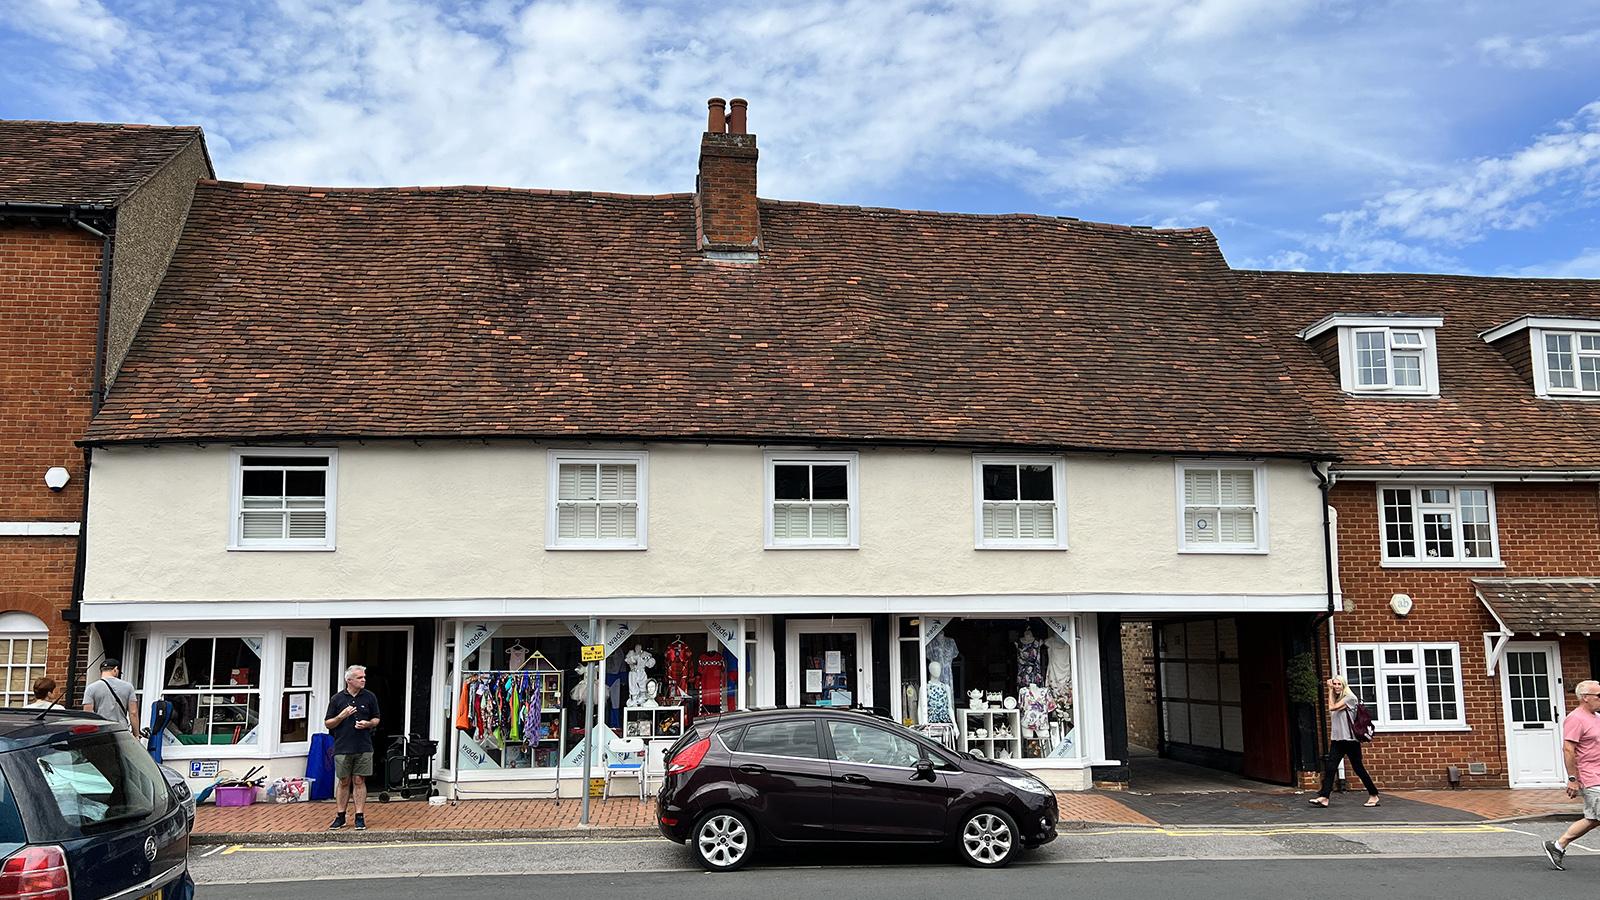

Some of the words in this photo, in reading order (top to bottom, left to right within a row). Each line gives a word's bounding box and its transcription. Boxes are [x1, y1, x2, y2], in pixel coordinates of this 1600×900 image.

[573, 623, 590, 640] wade
[711, 620, 728, 638] wade
[464, 631, 484, 648] wade
[607, 630, 626, 647] wade
[462, 743, 480, 761] wade
